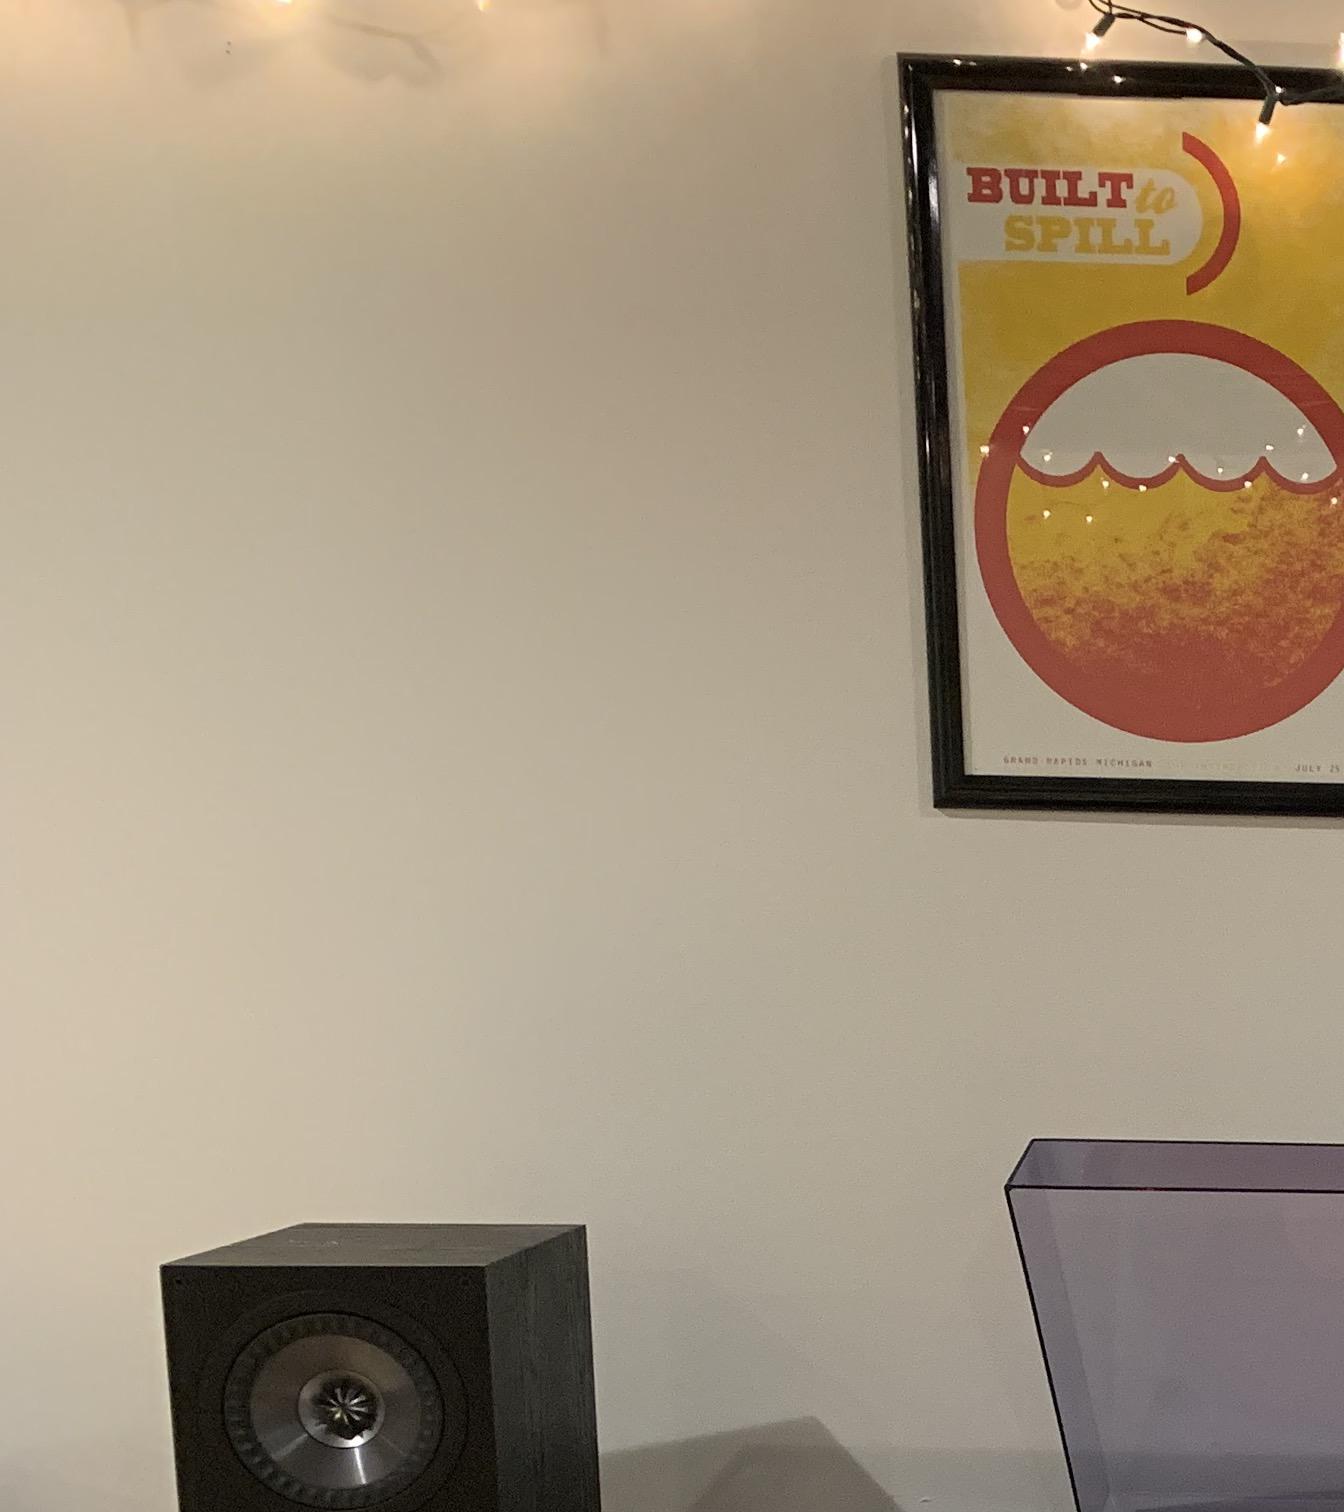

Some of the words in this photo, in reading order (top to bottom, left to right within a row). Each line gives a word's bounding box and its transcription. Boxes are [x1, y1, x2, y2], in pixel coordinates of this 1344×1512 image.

[966, 167, 1134, 208] BUILT
[1135, 177, 1177, 214] to
[1004, 214, 1171, 256] SPILL
[1295, 764, 1321, 773] JULY
